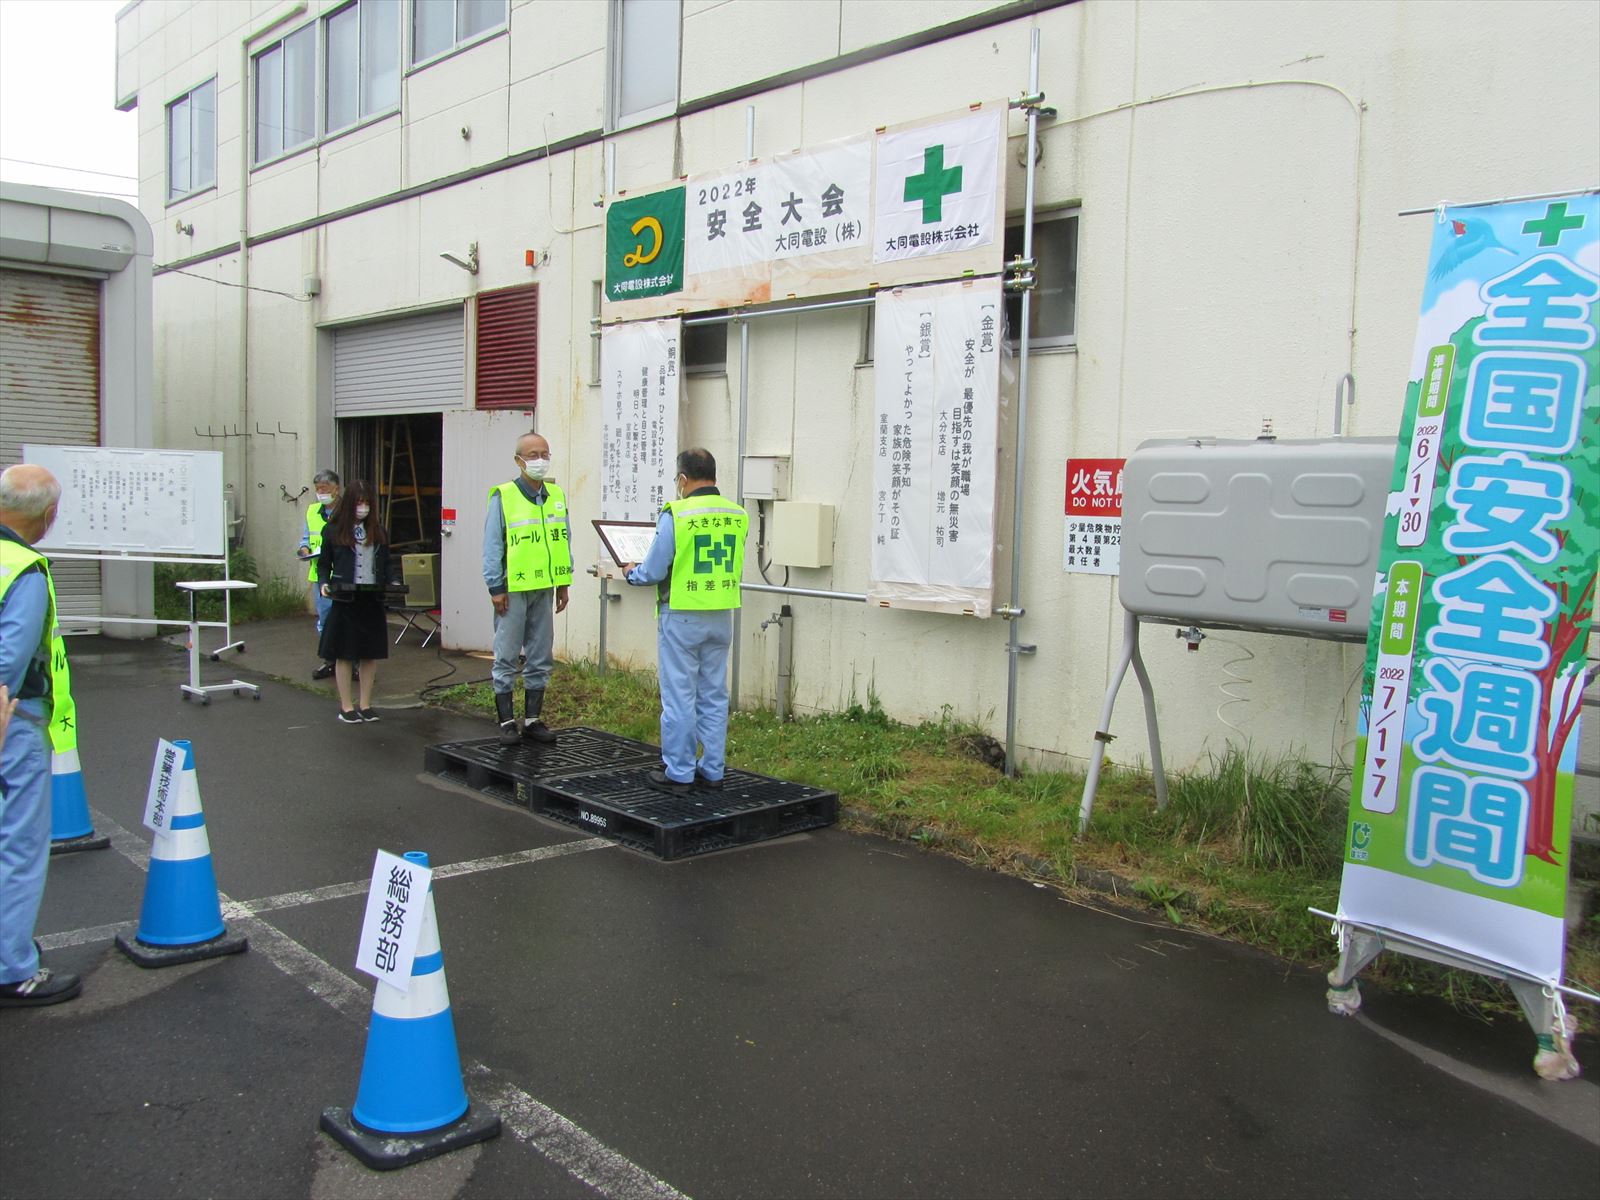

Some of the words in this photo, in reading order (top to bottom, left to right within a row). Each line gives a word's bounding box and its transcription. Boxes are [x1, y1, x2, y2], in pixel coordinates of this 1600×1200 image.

[698, 177, 757, 205] 2022年
[707, 183, 844, 241] 安全大会
[886, 223, 980, 251] 大同電設株式会社
[613, 273, 673, 294] 大同電設株式会社
[980, 304, 995, 353] 【金賞】
[1417, 425, 1438, 436] 2022
[1072, 497, 1086, 508] DO
[1091, 498, 1113, 508] NOT
[687, 516, 742, 530] 大きな声で
[1401, 512, 1422, 532] 30
[510, 530, 541, 547] ルール
[1406, 254, 1600, 887] 全国安全週間
[1389, 578, 1411, 640] 本期間
[1380, 668, 1405, 680] 2022
[60, 715, 74, 732] 大
[1372, 774, 1387, 798] 7
[375, 865, 412, 973] 総務部
